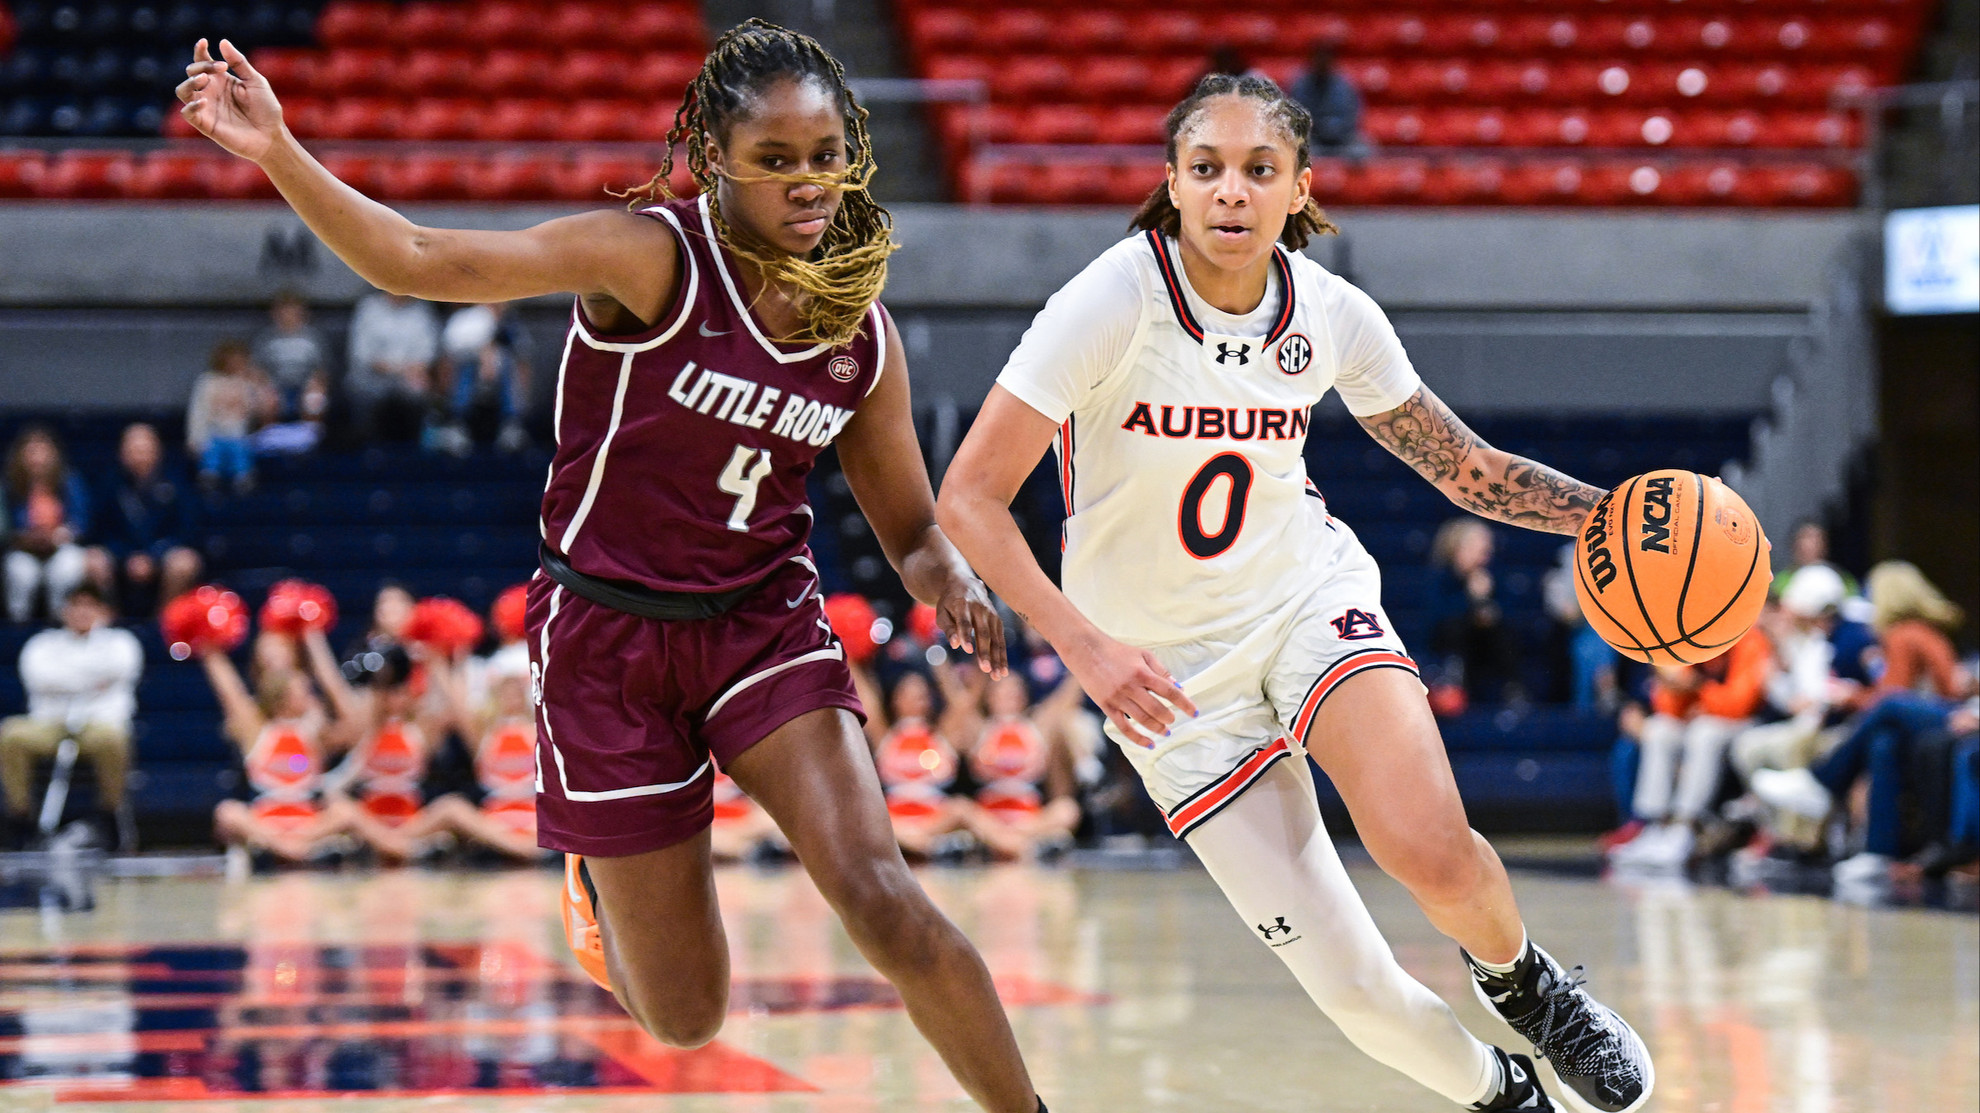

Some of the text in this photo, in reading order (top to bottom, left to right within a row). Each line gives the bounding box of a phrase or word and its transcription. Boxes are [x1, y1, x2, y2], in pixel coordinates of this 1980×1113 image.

[834, 362, 854, 375] OVC
[1279, 335, 1310, 373] SEC
[667, 360, 782, 429] LITTLE
[1121, 401, 1311, 441] AUBURN
[716, 443, 772, 533] 4
[1178, 451, 1254, 560] 0
[1641, 477, 1676, 555] NCAA
[1672, 516, 1680, 555] OFFICIAL
